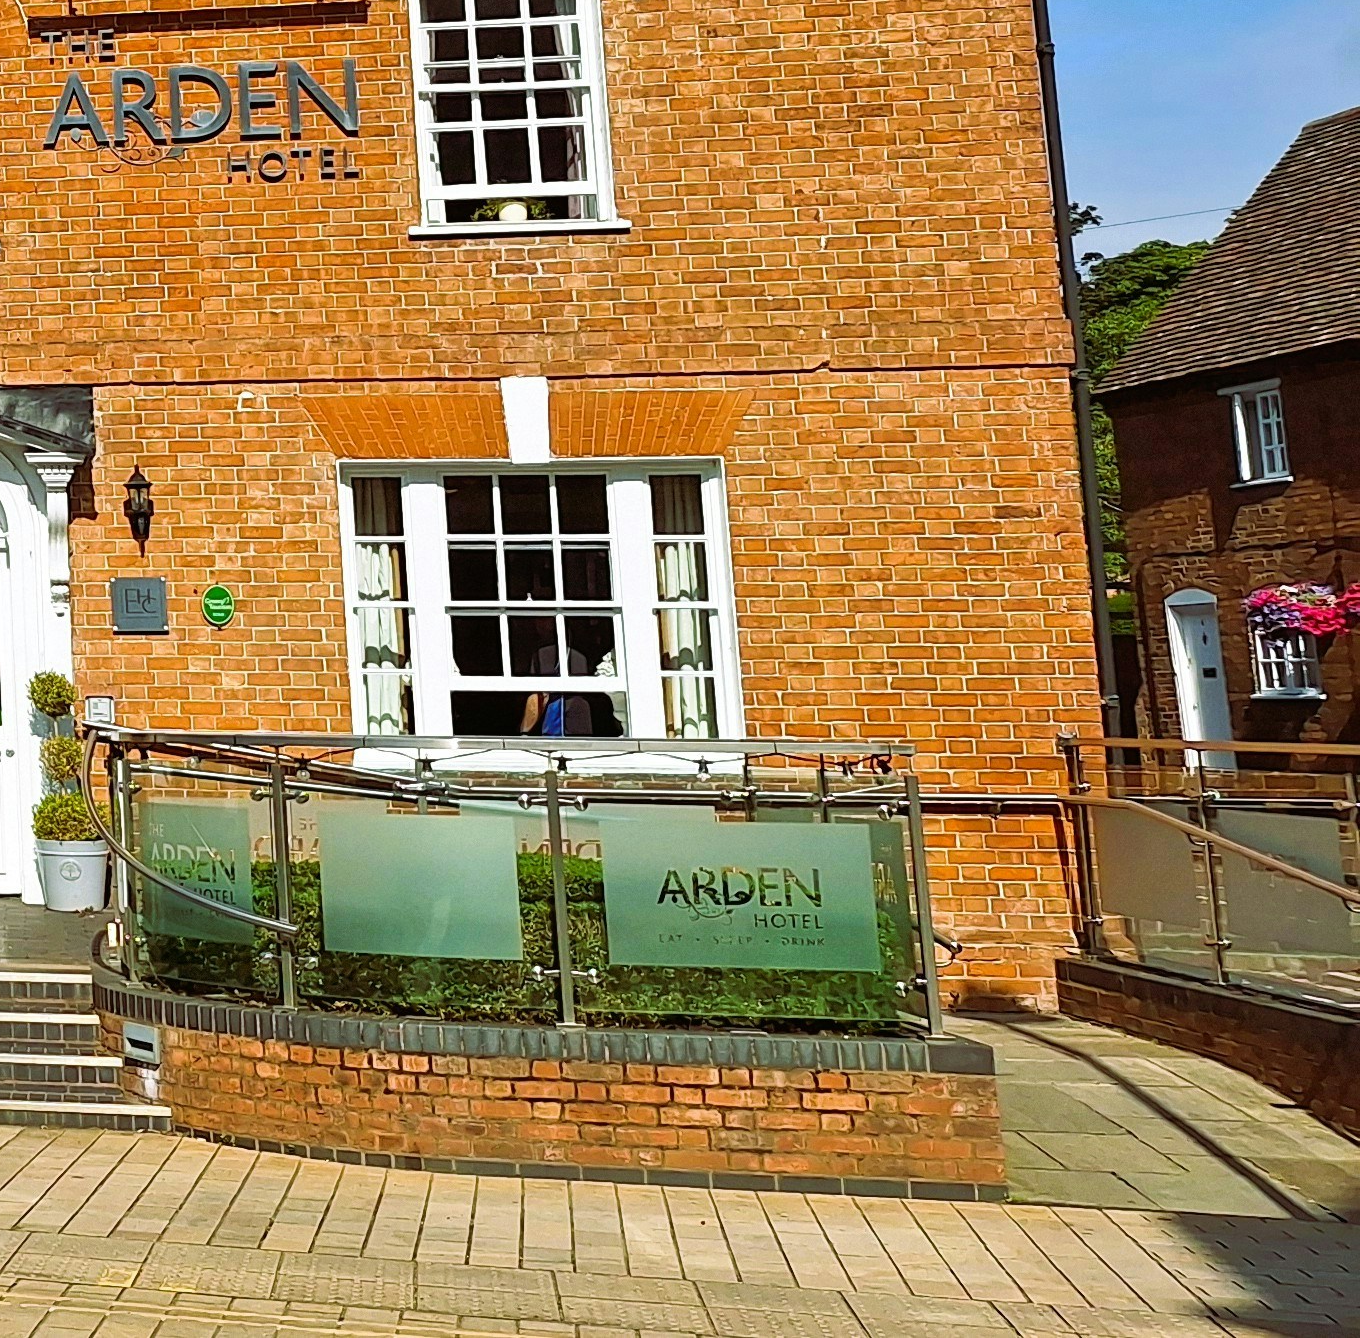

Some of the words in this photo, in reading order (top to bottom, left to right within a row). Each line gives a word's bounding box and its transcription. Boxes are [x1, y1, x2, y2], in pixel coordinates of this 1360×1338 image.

[40, 28, 116, 62] THE
[44, 59, 360, 149] ARDEN
[227, 146, 360, 183] HOTEL
[148, 822, 164, 837] THE
[657, 866, 822, 908] ARDEN
[754, 913, 824, 929] HOTEL
[781, 937, 825, 946] DRINK
